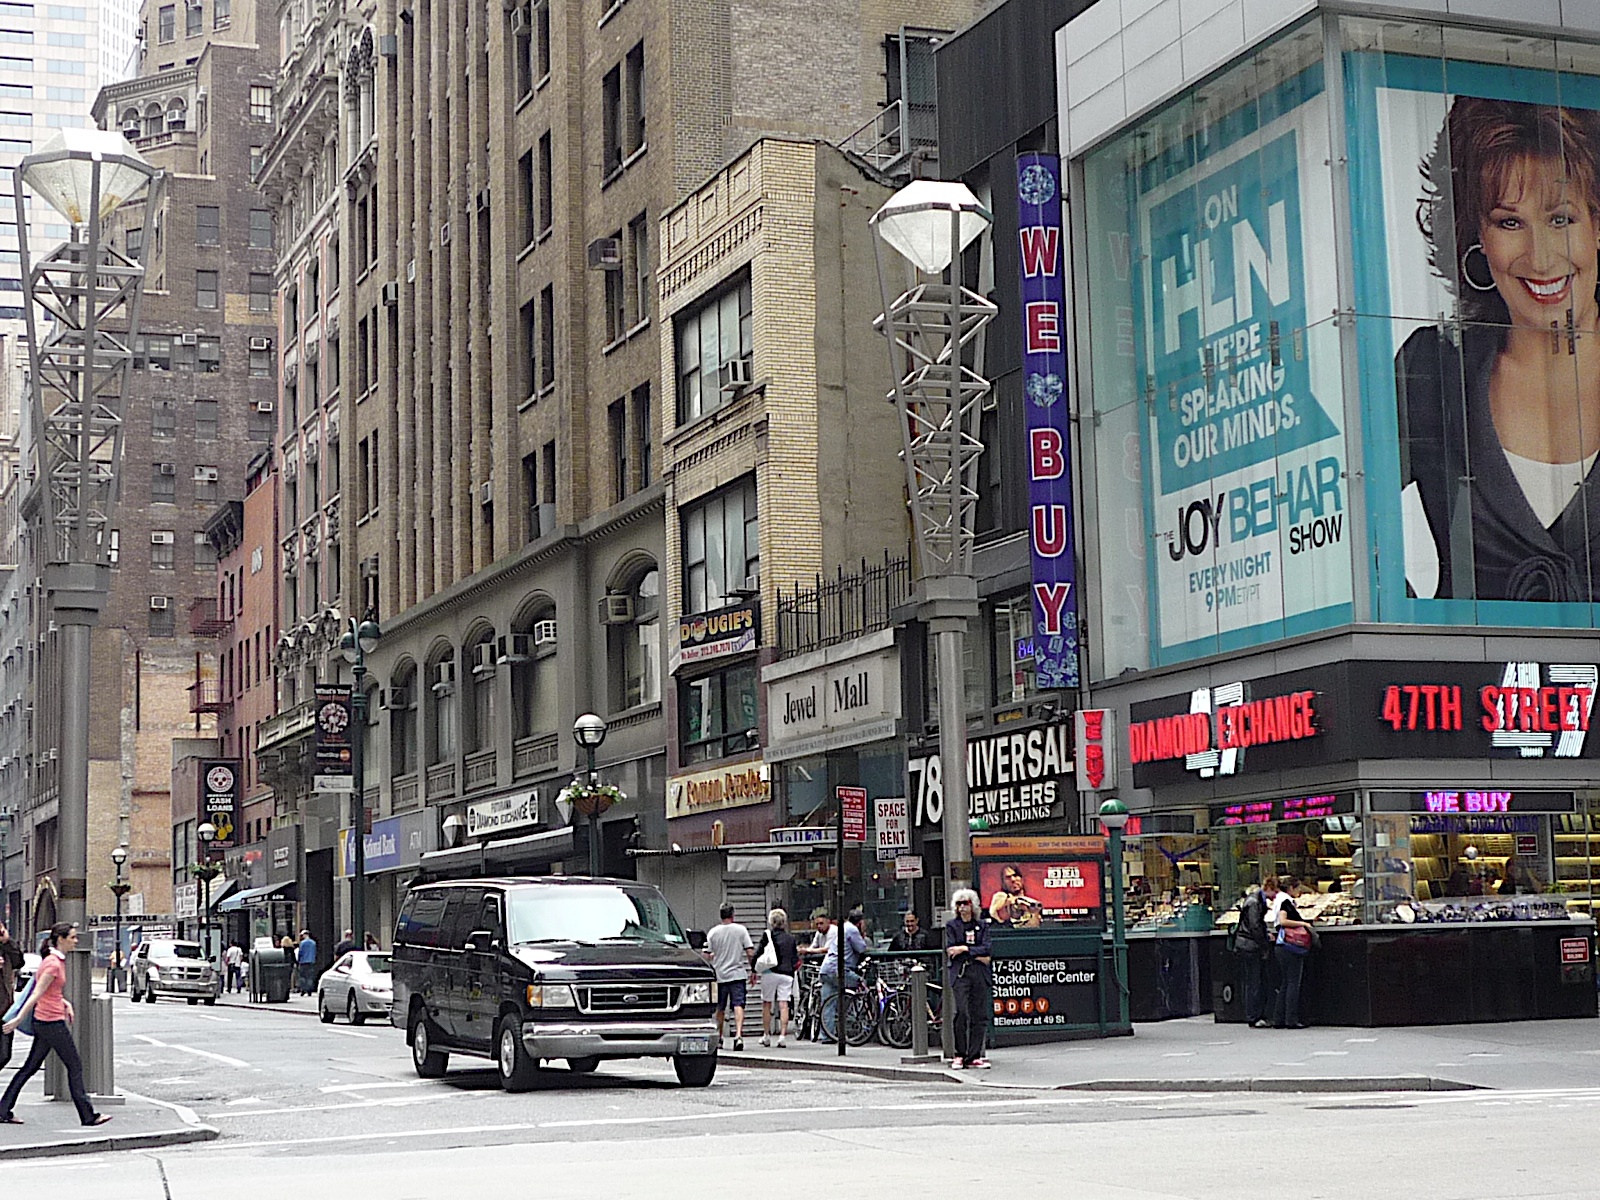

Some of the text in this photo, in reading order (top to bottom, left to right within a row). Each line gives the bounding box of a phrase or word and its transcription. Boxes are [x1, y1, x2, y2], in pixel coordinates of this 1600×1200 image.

[1204, 185, 1239, 229] ON
[1161, 200, 1291, 355] HLN
[1198, 322, 1262, 377] WE'RE
[1181, 358, 1285, 426] SPEAKING
[1174, 393, 1301, 468] OUR MINDS.
[1168, 492, 1225, 561] JOY
[1228, 456, 1343, 543] BEHAR
[1290, 514, 1342, 555] SHOW
[1189, 551, 1272, 594] EVERY NIGHT
[1205, 591, 1214, 613] 9
[783, 685, 816, 725] Jewel
[833, 671, 869, 713] Mall
[1382, 684, 1592, 733] 47TH STREET
[1129, 690, 1315, 763] DIAMOND EXCHANGE
[967, 724, 1074, 788] NIVERSAL
[878, 803, 906, 817] SPACE
[968, 780, 1058, 815] JEWELERS
[1425, 791, 1513, 812] WE BUY
[476, 812, 499, 830] DIAMOND
[885, 819, 898, 829] FOR
[1004, 805, 1051, 823] FINDINGS
[382, 833, 396, 855] Bank
[879, 830, 906, 845] RENT
[992, 971, 1095, 985] Rockefeller Center
[1025, 959, 1066, 972] Streets
[992, 985, 1031, 998] Station
[1008, 1002, 1016, 1011] D
[1038, 1001, 1046, 1011] V
[999, 1015, 1065, 1026] Elevator at 49 St
